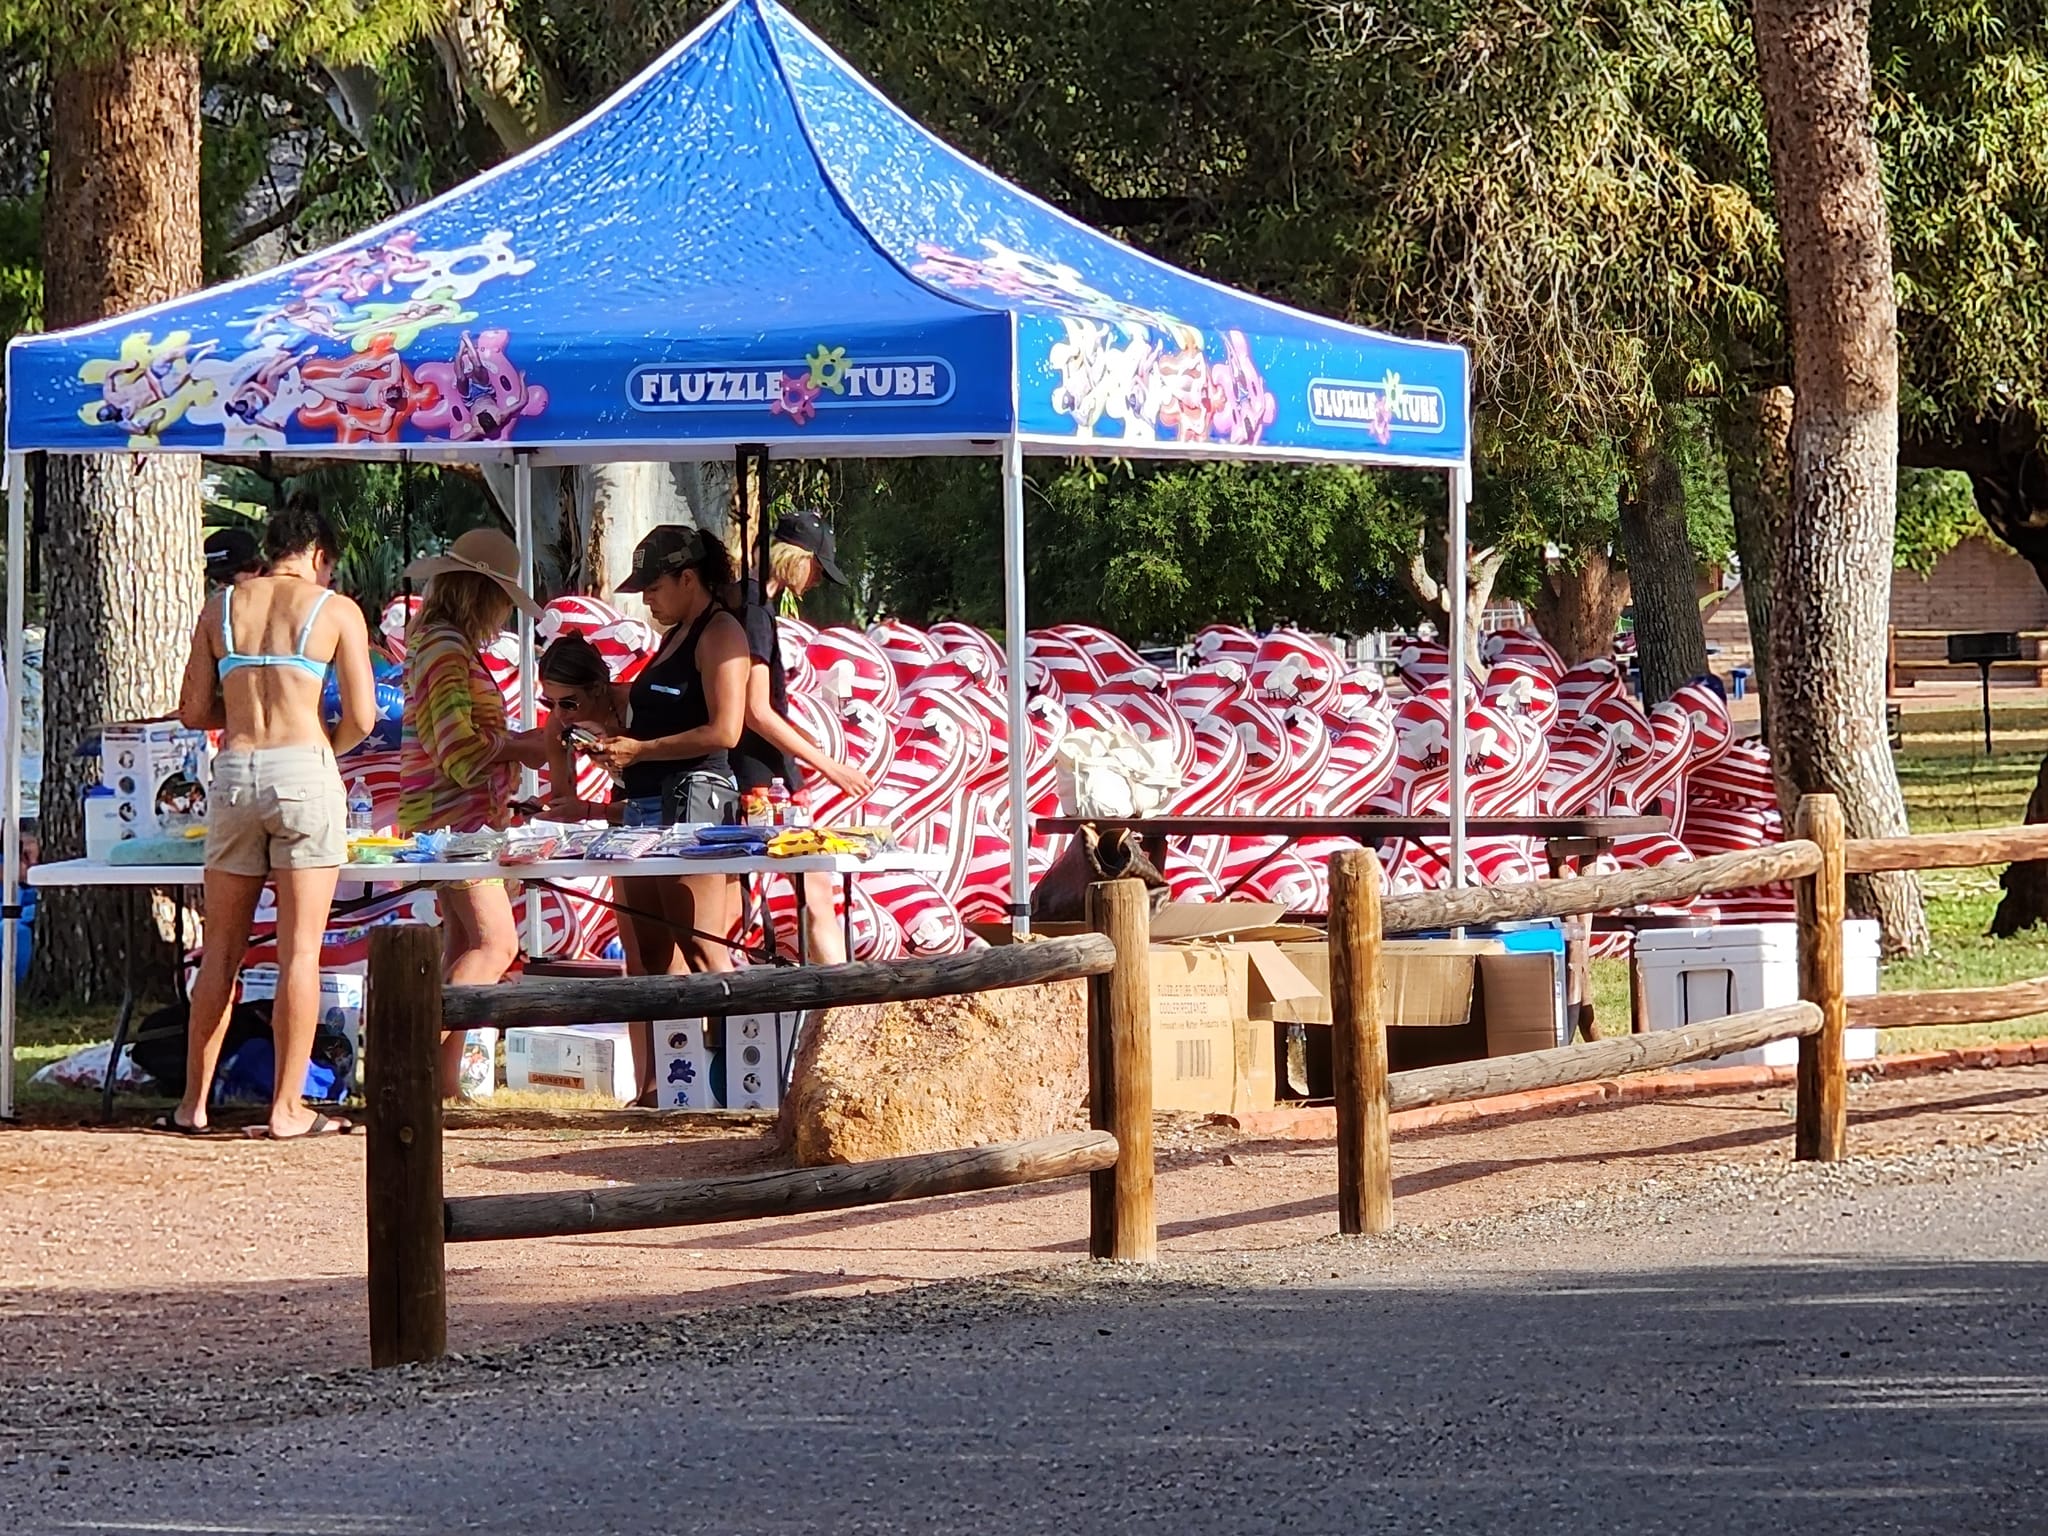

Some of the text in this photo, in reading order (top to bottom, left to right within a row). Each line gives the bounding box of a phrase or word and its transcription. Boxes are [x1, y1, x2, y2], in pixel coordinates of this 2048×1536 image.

[640, 365, 936, 403] FLUZZLE TUBE
[1312, 387, 1439, 424] FLUZZLE TUBE
